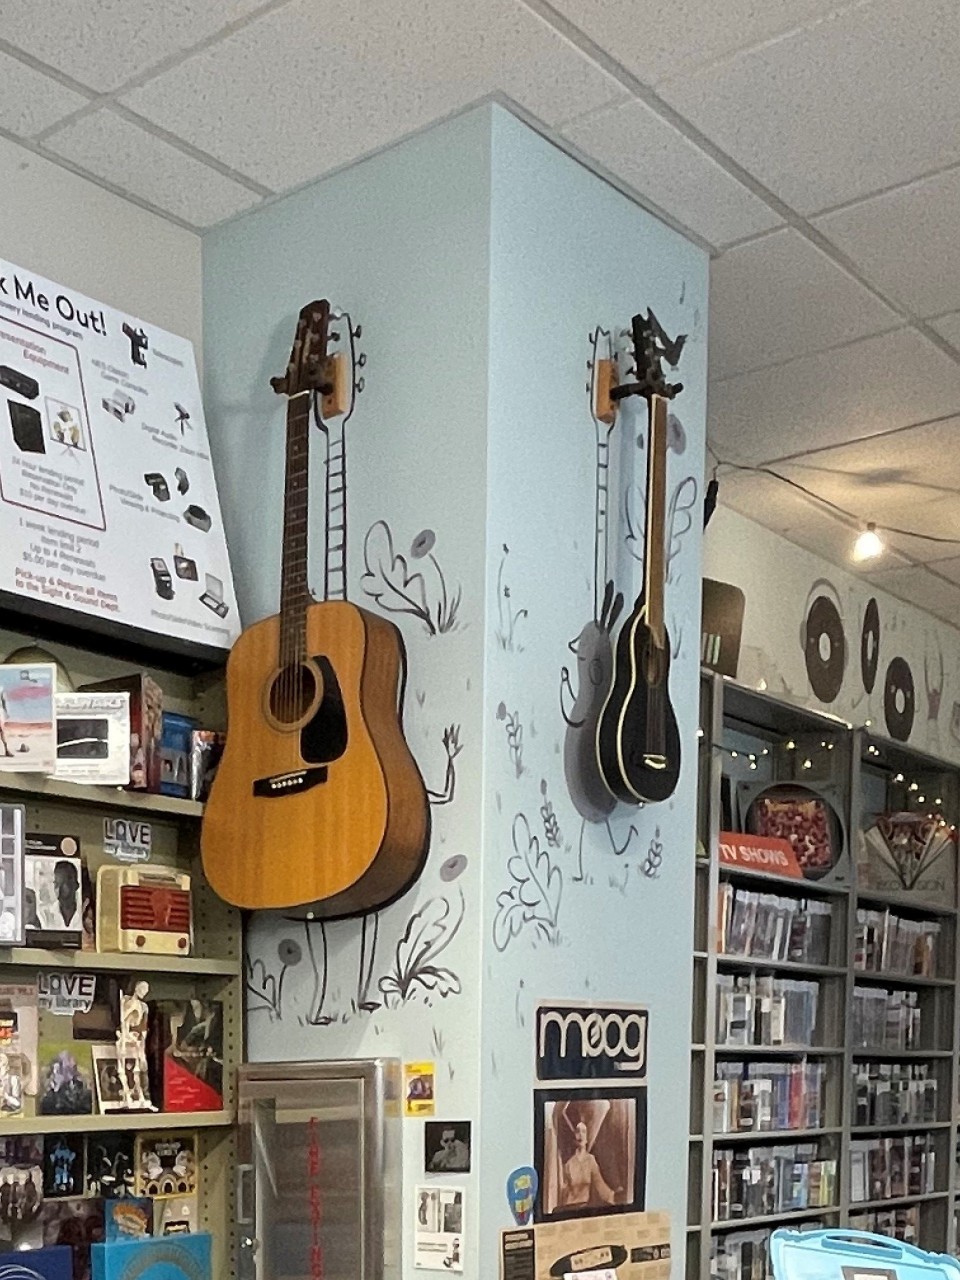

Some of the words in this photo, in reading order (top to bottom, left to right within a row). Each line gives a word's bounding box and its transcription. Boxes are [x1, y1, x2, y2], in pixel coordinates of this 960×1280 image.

[14, 275, 49, 311] Me
[56, 295, 106, 336] Out!
[104, 818, 150, 844] LOVE
[720, 842, 737, 860] TV
[739, 844, 789, 866] SHOWS
[38, 972, 94, 995] LOVE
[540, 1011, 646, 1070] moog
